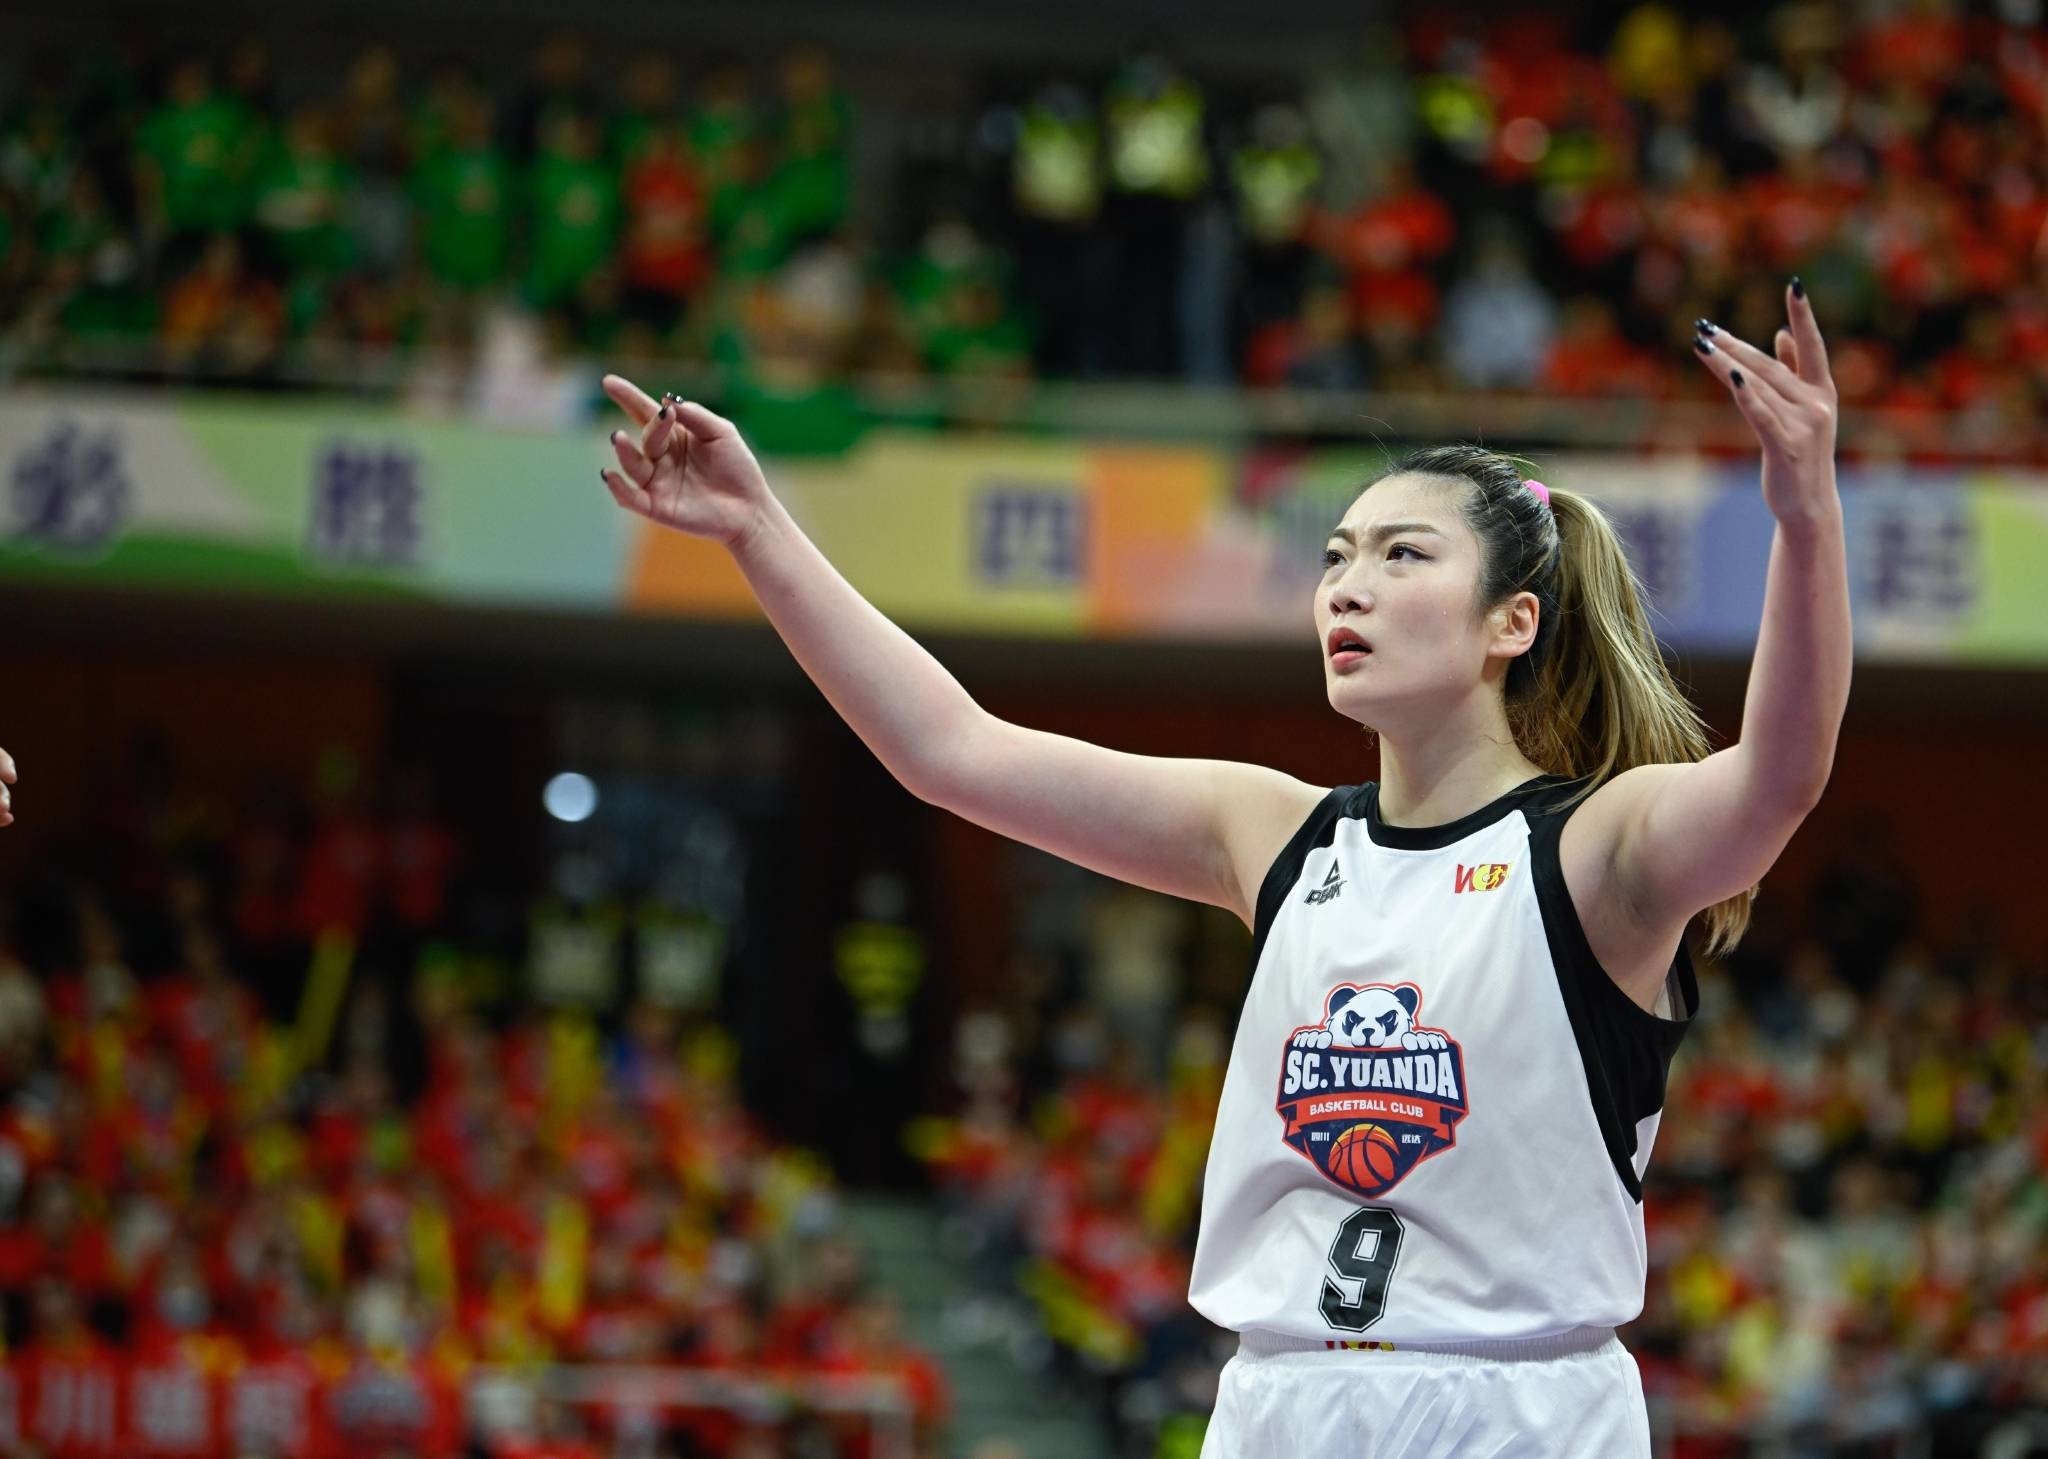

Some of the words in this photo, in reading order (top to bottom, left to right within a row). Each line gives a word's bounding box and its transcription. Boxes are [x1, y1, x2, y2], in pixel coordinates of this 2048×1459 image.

[1304, 880, 1347, 906] PEAK
[1310, 1099, 1387, 1116] BASKETBALL
[1390, 1102, 1424, 1118] CLUB
[1318, 1206, 1405, 1333] 9
